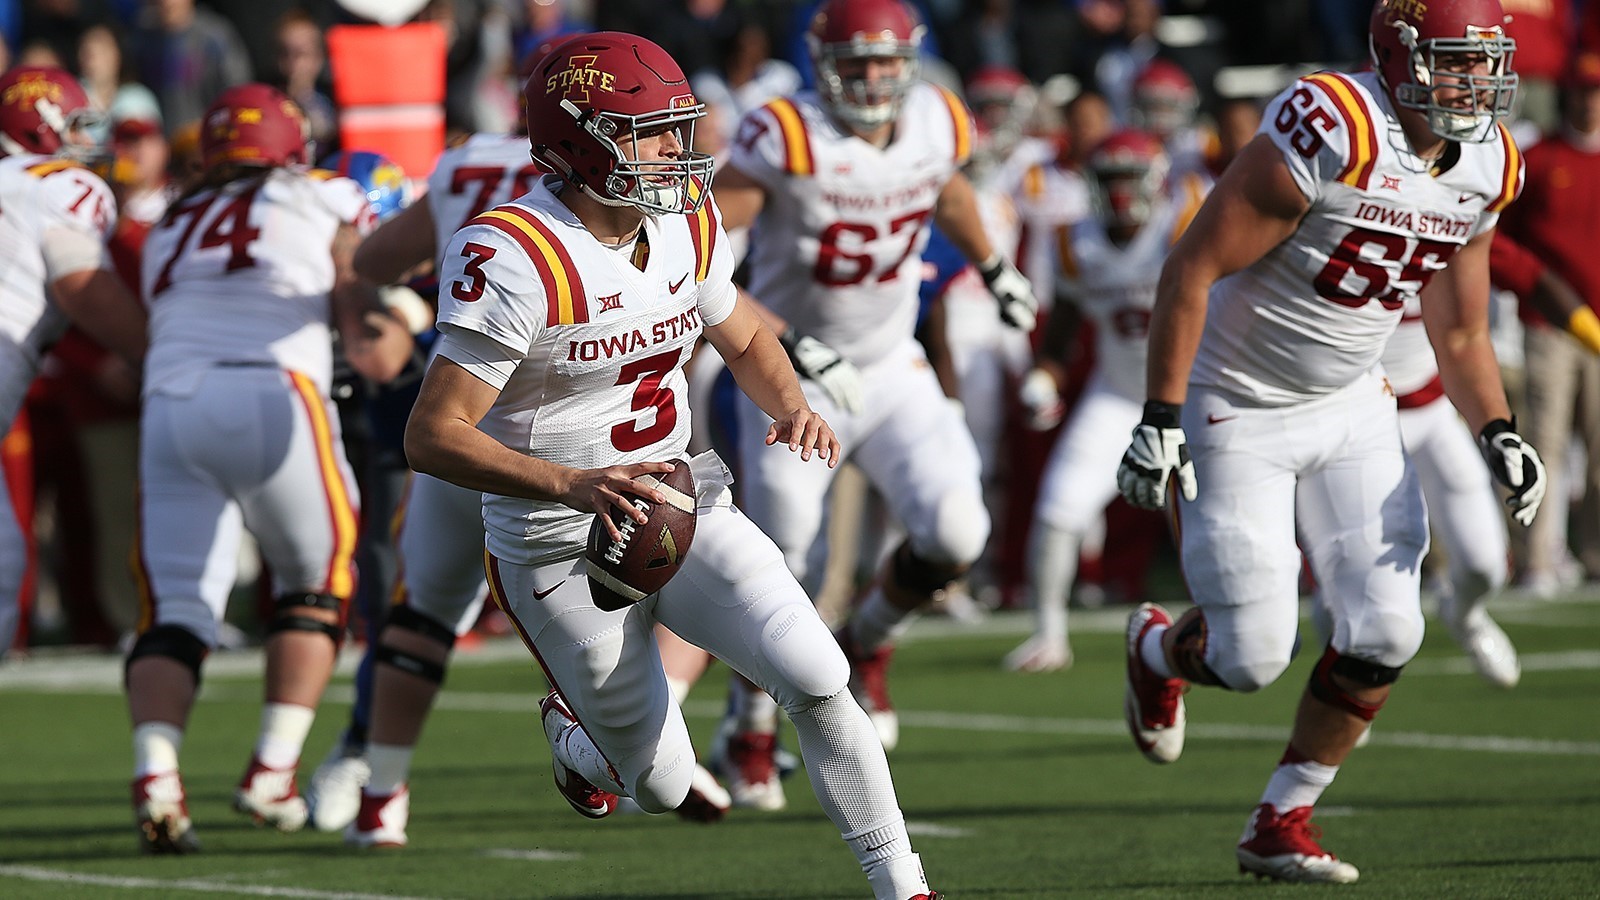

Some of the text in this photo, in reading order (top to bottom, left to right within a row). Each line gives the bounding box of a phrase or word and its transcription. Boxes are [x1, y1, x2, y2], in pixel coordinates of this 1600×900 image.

[545, 68, 616, 95] STATE
[1275, 88, 1337, 158] 65
[152, 184, 262, 297] 74
[1355, 203, 1413, 230] IOWA
[451, 241, 497, 302] 3
[813, 208, 934, 287] 67
[1313, 227, 1457, 311] 65
[567, 305, 703, 362] IOWA STAT
[610, 346, 684, 453] 3
[769, 611, 799, 642] schutt
[651, 754, 682, 780] schutt
